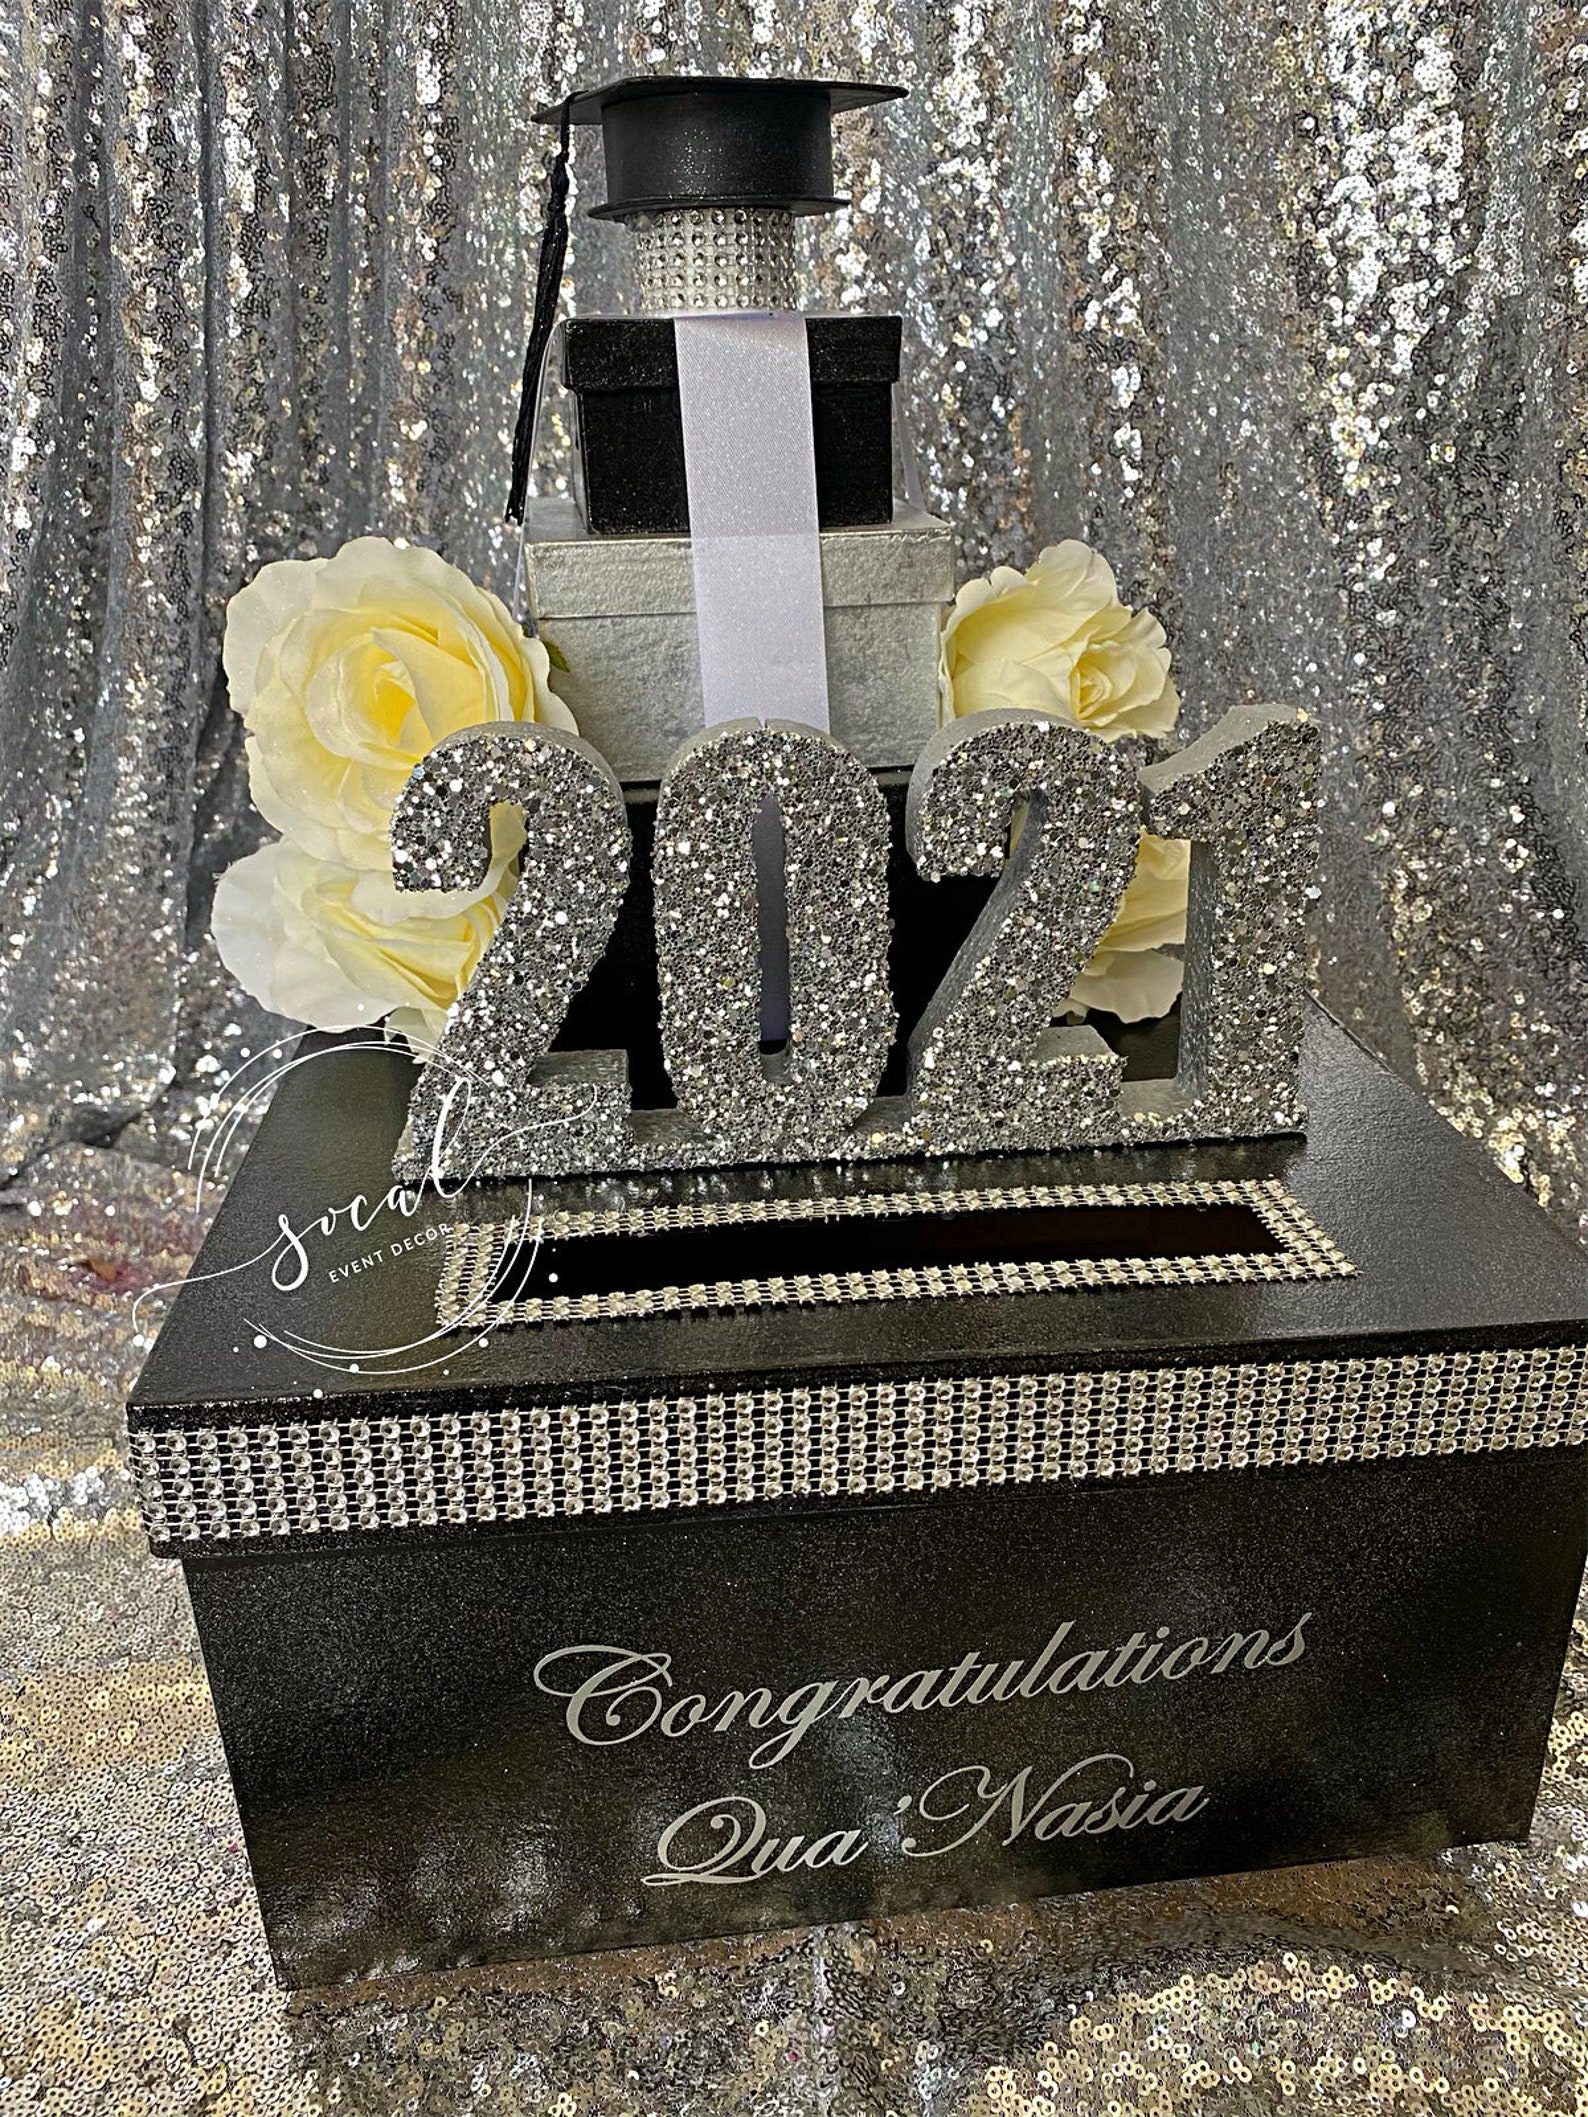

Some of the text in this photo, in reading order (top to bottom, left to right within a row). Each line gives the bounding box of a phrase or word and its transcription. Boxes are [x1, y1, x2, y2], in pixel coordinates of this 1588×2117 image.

[390, 703, 1323, 1181] 2021
[533, 1611, 1313, 1769] Congratulations
[640, 1796, 871, 1887] Qua
